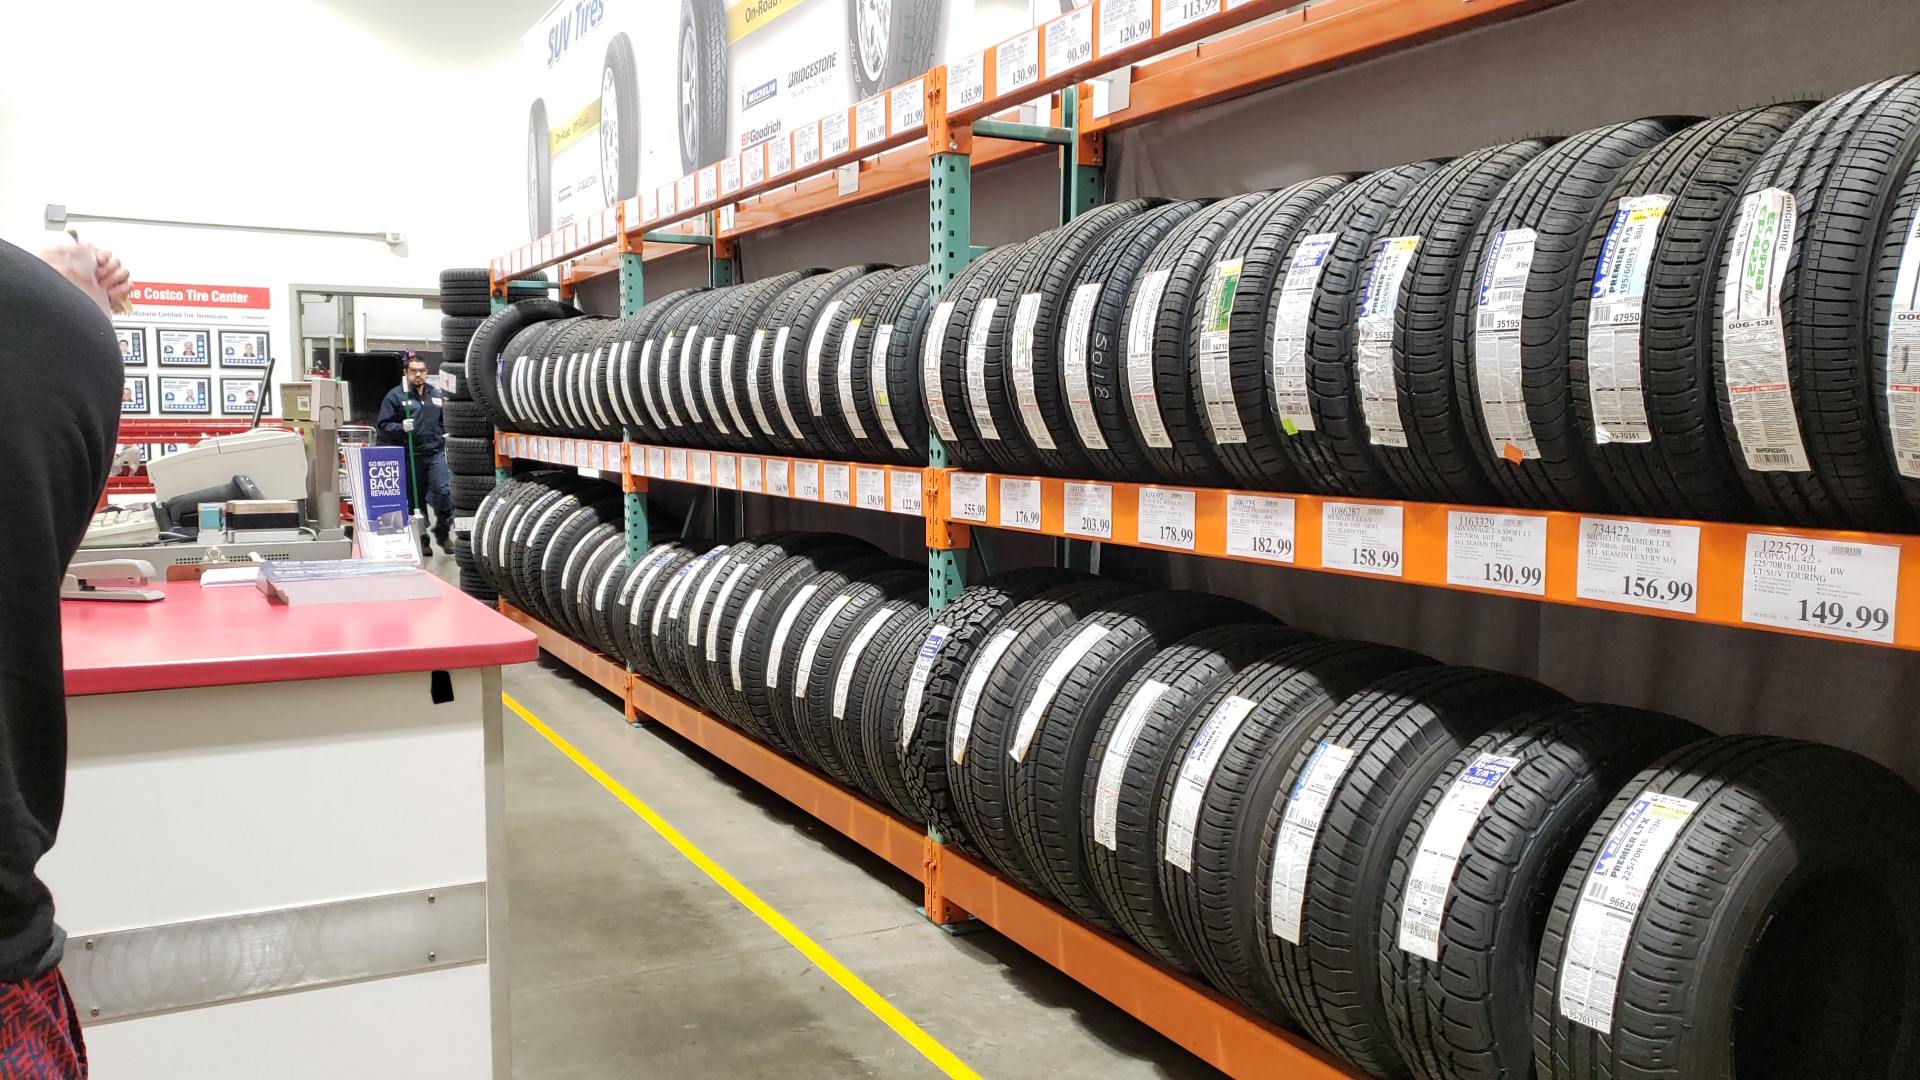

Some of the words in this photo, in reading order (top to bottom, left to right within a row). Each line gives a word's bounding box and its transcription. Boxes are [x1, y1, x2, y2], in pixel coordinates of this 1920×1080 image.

[548, 10, 573, 67] SUV
[575, 0, 604, 42] Tires
[1119, 19, 1151, 44] 120.99
[1067, 42, 1090, 64] 90.99
[788, 52, 837, 89] BRIDGESTONE
[1012, 63, 1037, 85] 130.99
[748, 82, 777, 105] MICHELIN
[961, 85, 982, 104] 135.99
[903, 109, 923, 127] 121.99
[742, 118, 782, 147] BFGoodrich
[867, 124, 885, 141] 161.99
[1600, 211, 1628, 275] MICHELIN
[1747, 204, 1767, 278] EP422
[1755, 211, 1776, 291] ECOPIA
[1484, 236, 1503, 286] MICHELIN
[1515, 261, 1530, 269] 91H
[1608, 246, 1627, 294] PREMIER
[1622, 226, 1634, 243] A/S
[1620, 246, 1637, 295] 195/60R15
[144, 287, 183, 301] Costco
[186, 289, 208, 302] Tire
[211, 290, 249, 304] Center
[1372, 273, 1386, 314] PREMIER
[1496, 319, 1520, 329] 35195
[1613, 312, 1640, 323] 47950
[369, 467, 400, 478] CASH
[370, 477, 400, 490] BACK
[371, 488, 400, 497] REWARDS
[902, 498, 921, 511] 122.99
[964, 503, 985, 517] 255.99
[1233, 499, 1256, 509] 696225
[1331, 506, 1361, 517] 1086287
[1016, 510, 1040, 525] 176.99
[1081, 516, 1110, 533] 203.99
[1459, 515, 1495, 528] 1163329
[1160, 525, 1193, 544] 178.99
[1337, 527, 1356, 535] SEASON
[1454, 525, 1490, 534] ADVANTAGE
[1502, 529, 1521, 537] SPORT
[1593, 523, 1629, 537] 734422
[1252, 536, 1292, 556] 182.99
[1466, 539, 1488, 548] SEASON
[1489, 541, 1503, 549] TIRE
[1586, 533, 1620, 543] MICHELIN
[1622, 536, 1654, 547] PREMIER
[1656, 539, 1671, 548] LTX
[1621, 543, 1637, 553] 103H
[1645, 546, 1661, 555] BSW
[1762, 540, 1815, 557] 1225791
[1352, 547, 1400, 569] 158.99
[1585, 548, 1599, 556] ALL
[1601, 549, 1628, 559] SEASON
[1630, 551, 1661, 562] LUXURY
[1662, 555, 1678, 564] SUV
[1753, 550, 1785, 562] ECOPIA
[1787, 555, 1799, 563] HL
[1483, 562, 1542, 587] 130.99
[1752, 567, 1783, 578] LT/SUV
[1786, 570, 1826, 583] TOURING
[1753, 559, 1792, 570] 225/70R16
[1796, 563, 1817, 573] 103H
[1829, 567, 1845, 577] BW
[1621, 575, 1693, 603] 156.99
[1797, 598, 1889, 633] 149.99
[1196, 730, 1217, 761] PREMIER
[1476, 768, 1490, 779] T/A
[1610, 836, 1638, 878] PREMIER
[1633, 817, 1651, 837] LTX
[1621, 839, 1649, 881] 225/70R16
[1647, 818, 1663, 834] 103H
[1609, 896, 1637, 911] 96620
[1568, 1010, 1599, 1028] 95-70111
